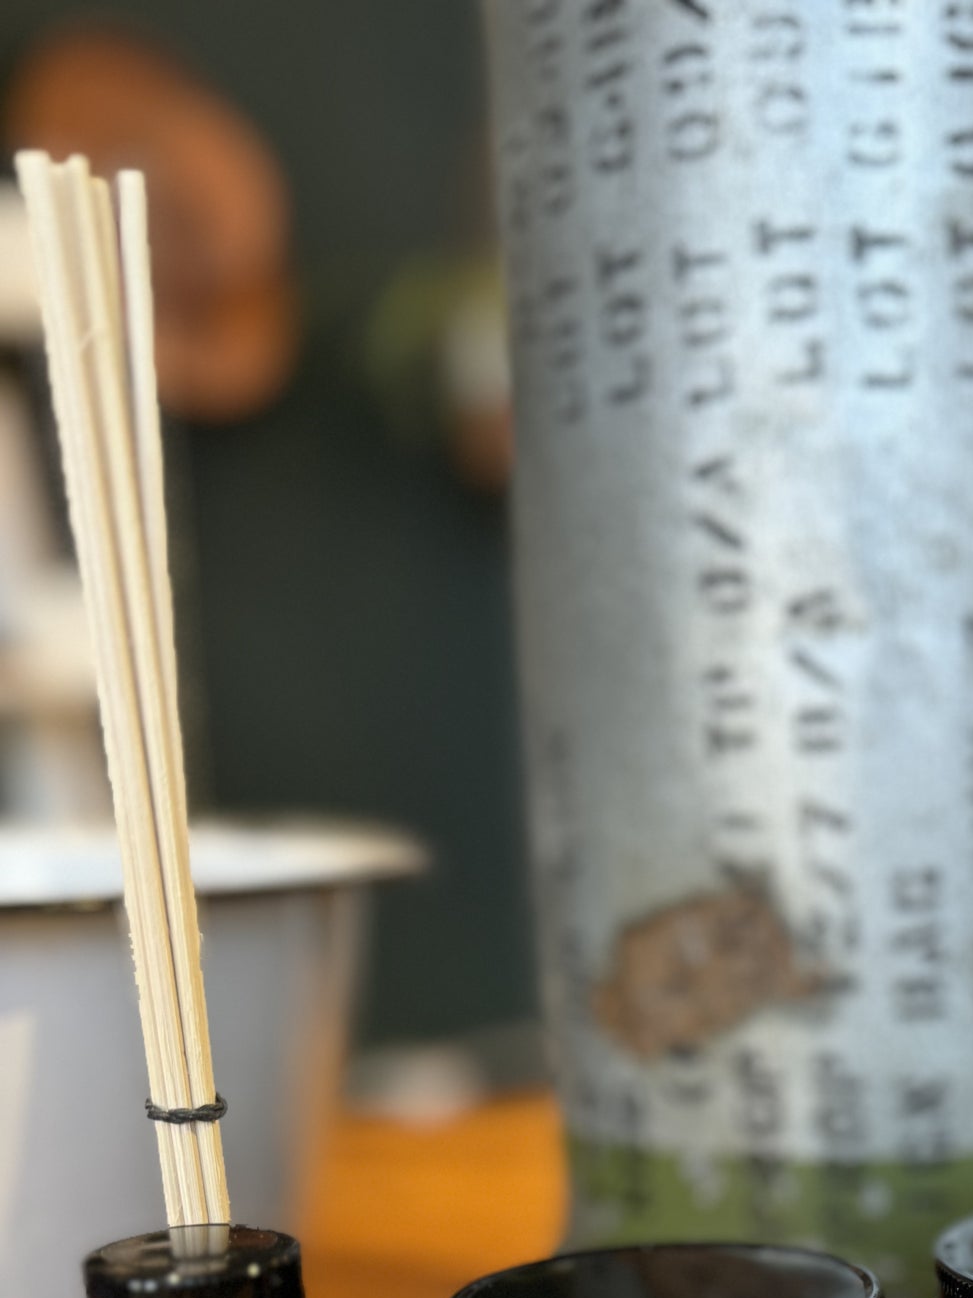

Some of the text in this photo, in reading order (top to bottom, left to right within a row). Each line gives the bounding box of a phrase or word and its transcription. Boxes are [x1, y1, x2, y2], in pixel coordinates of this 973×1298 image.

[598, 244, 652, 407] LOT
[674, 244, 733, 407] LOT
[754, 219, 823, 385] LOT
[850, 224, 911, 389] LOT
